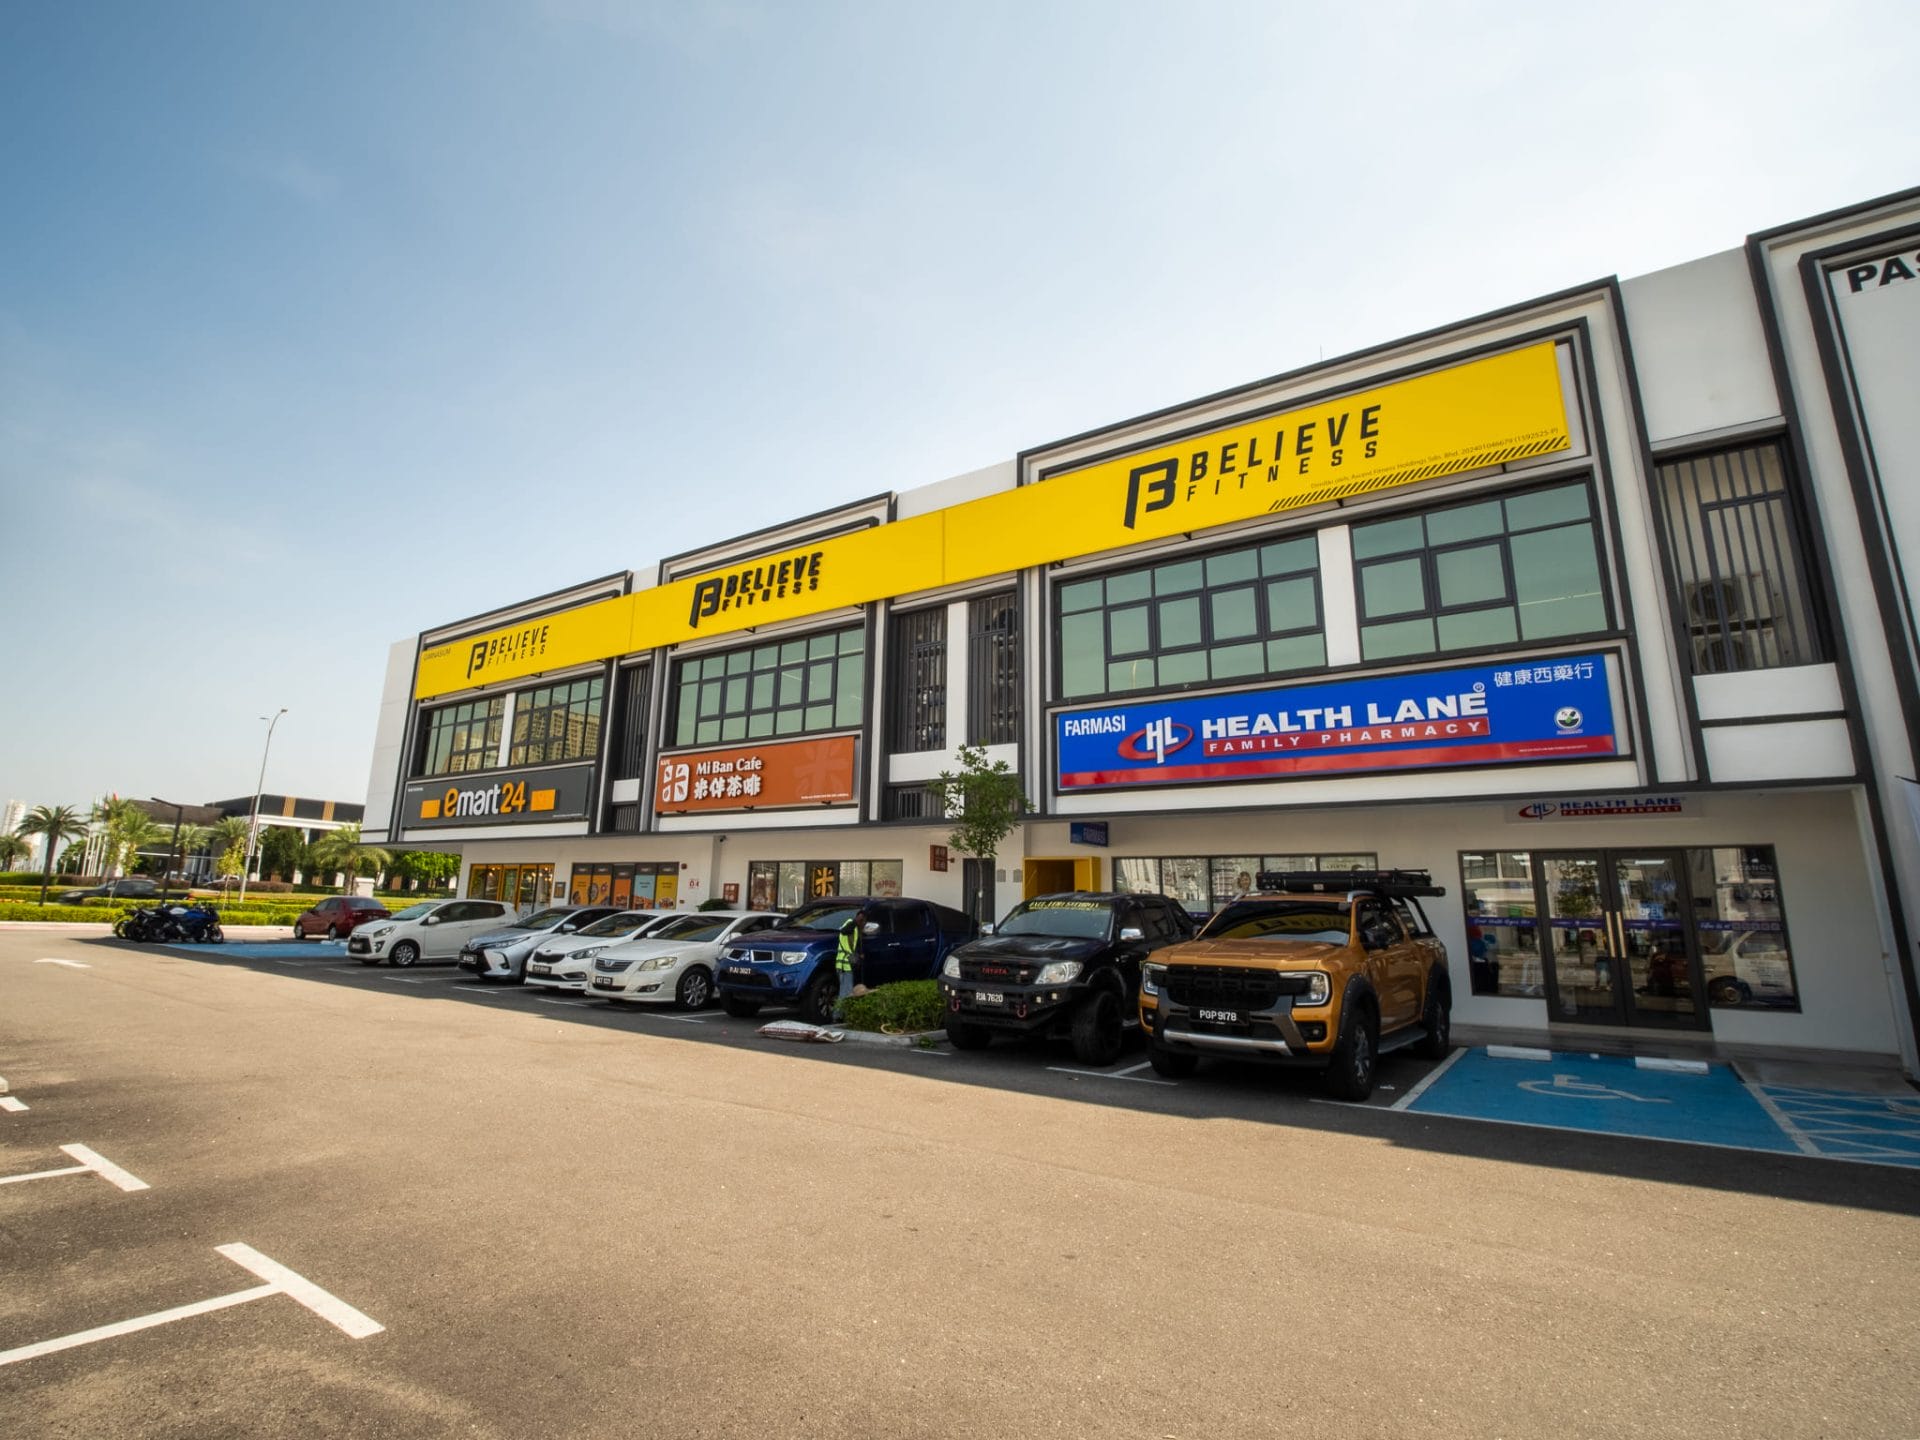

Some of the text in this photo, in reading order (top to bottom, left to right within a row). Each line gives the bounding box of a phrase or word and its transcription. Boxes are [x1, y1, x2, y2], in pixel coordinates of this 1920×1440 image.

[1846, 250, 1920, 294] PA
[1189, 404, 1382, 483] BELIEVE
[1186, 440, 1378, 502] FITNESS
[726, 552, 823, 596] BELIEVE
[722, 578, 818, 610] FITNESS
[487, 645, 547, 666] FITNESS
[490, 625, 550, 656] BELIEVE
[1493, 662, 1595, 688] 健康西藥行
[1064, 714, 1126, 738] FARMASI
[1202, 690, 1488, 740] HEALTH LANE
[1209, 720, 1481, 753] FAMILY PHARMACY
[696, 756, 763, 775] Mi Ban Cafe
[443, 780, 527, 818] emart24
[1560, 796, 1680, 809] HEALTH LANE
[1562, 805, 1680, 816] FAMILY PHARMACY
[1217, 1010, 1237, 1022] 9178
